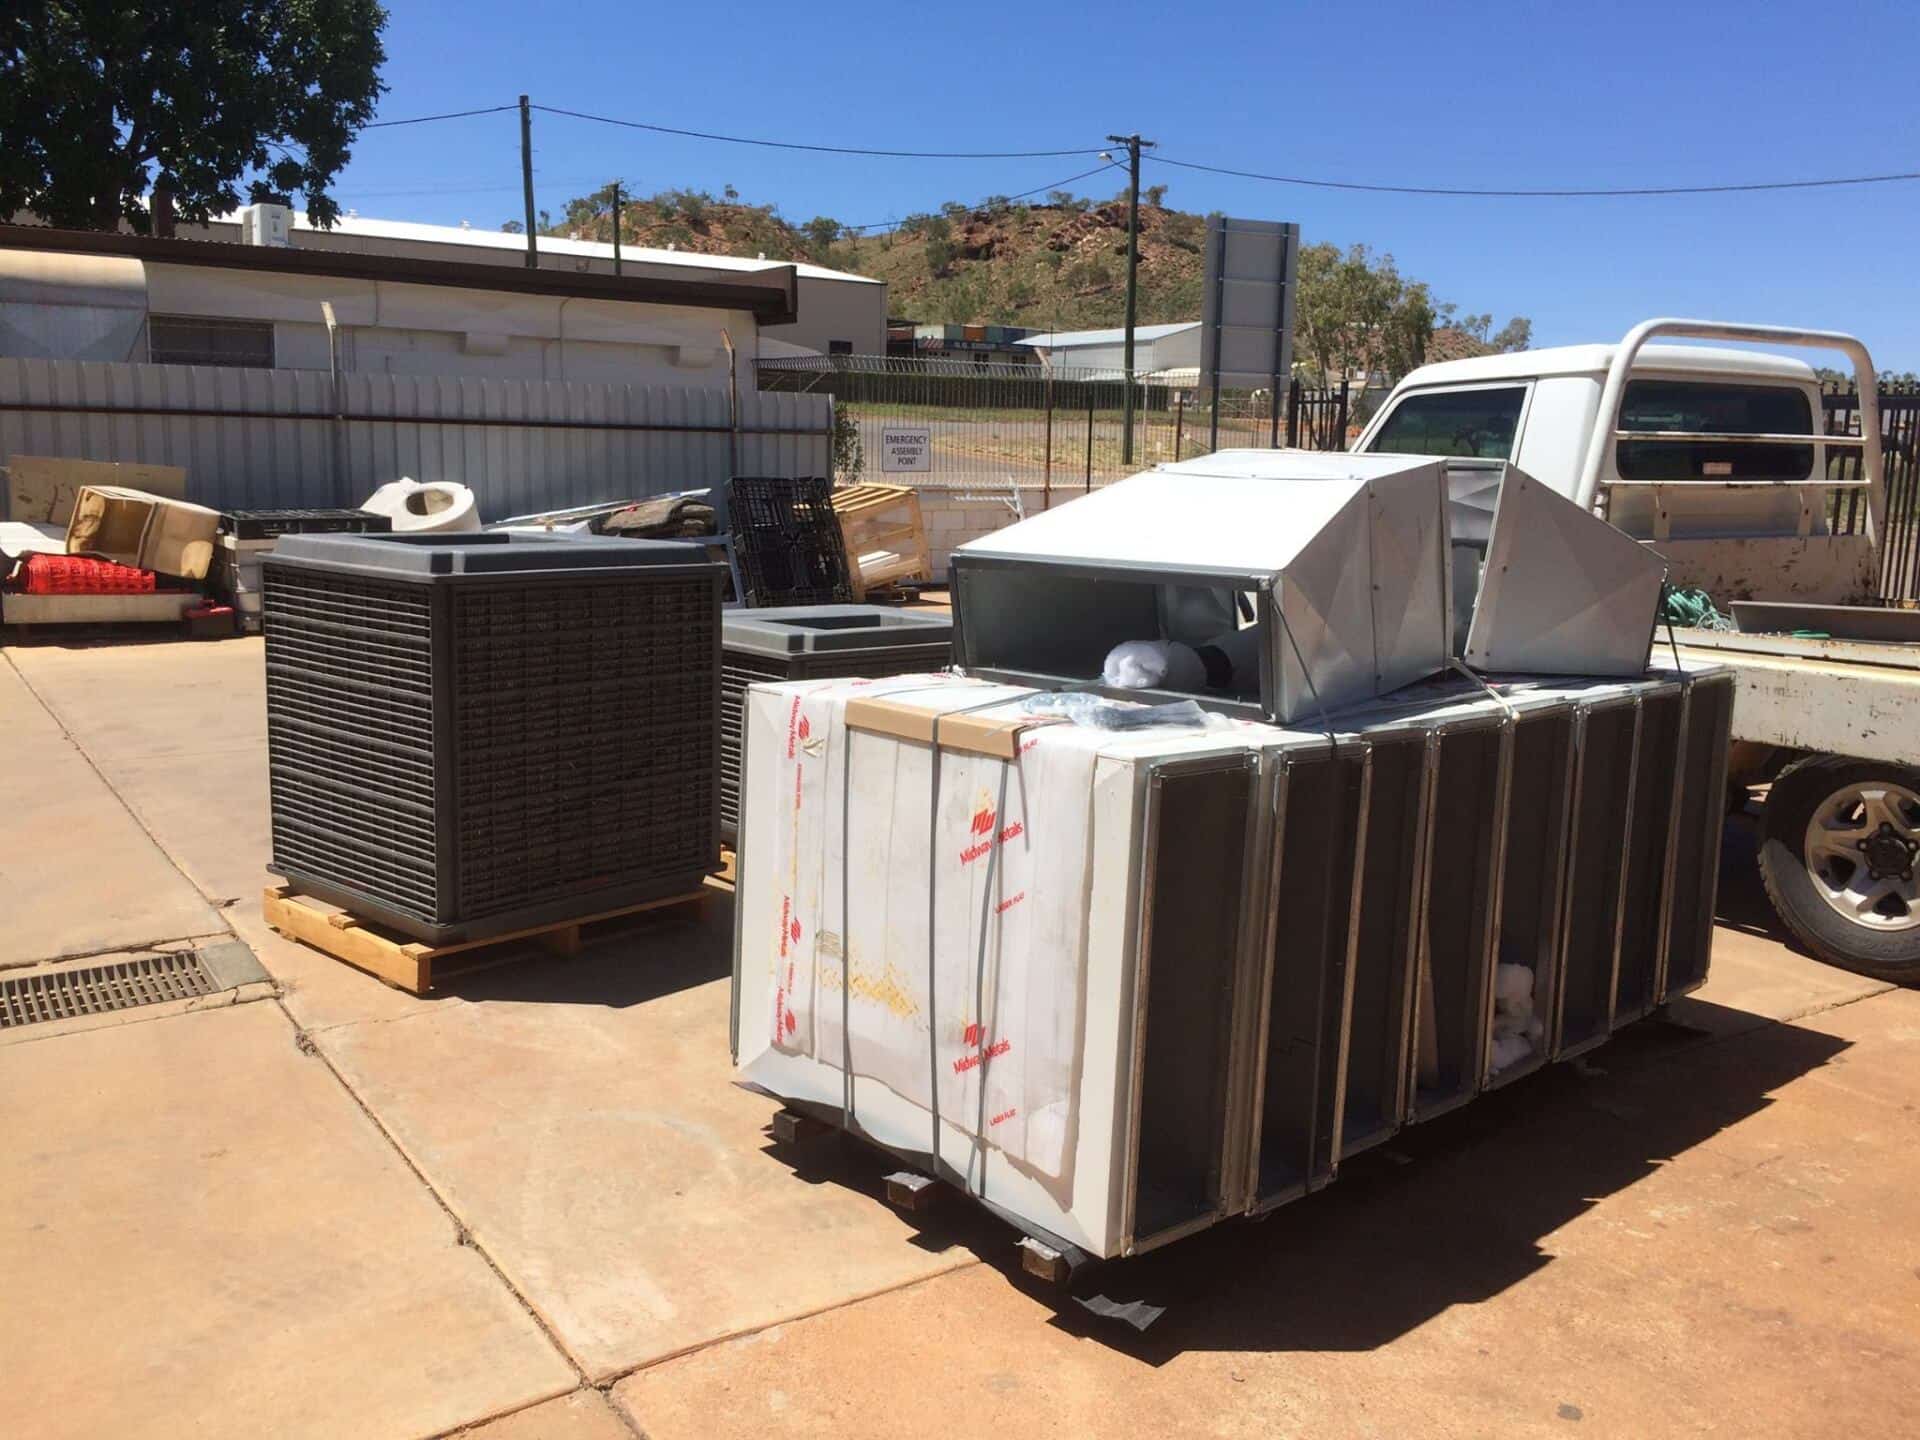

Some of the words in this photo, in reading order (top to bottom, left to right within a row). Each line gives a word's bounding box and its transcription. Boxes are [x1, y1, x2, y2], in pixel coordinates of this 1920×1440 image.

[885, 435, 928, 444] EMERGENCY
[891, 447, 922, 456] ASSEMBLY
[897, 457, 917, 465] POINT
